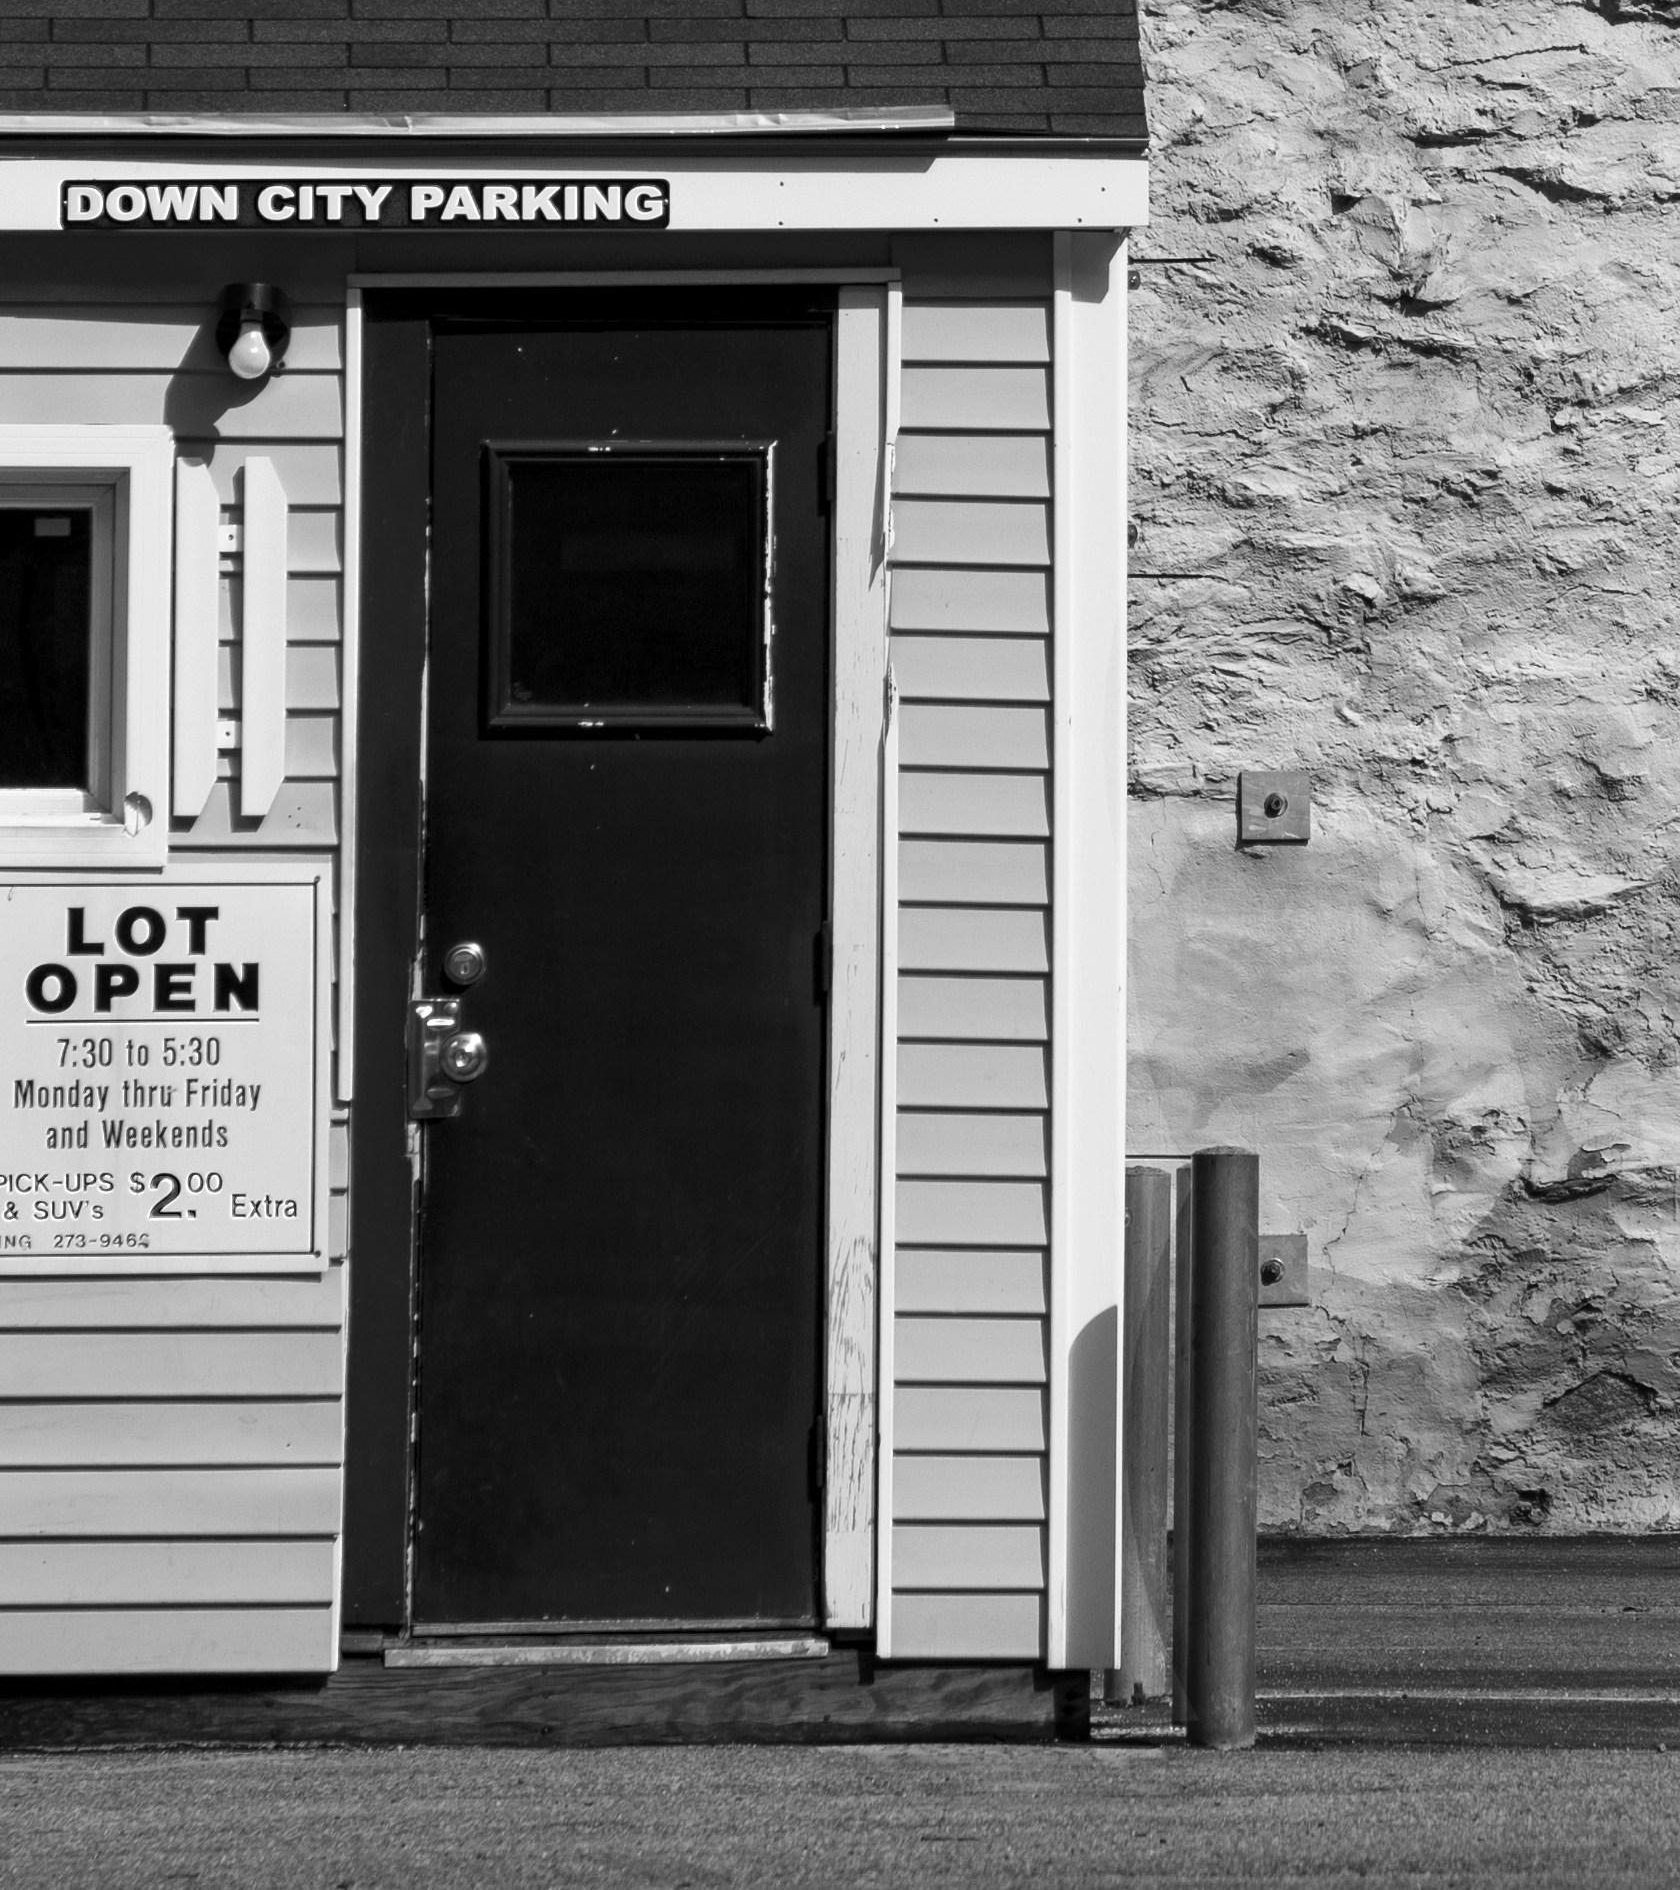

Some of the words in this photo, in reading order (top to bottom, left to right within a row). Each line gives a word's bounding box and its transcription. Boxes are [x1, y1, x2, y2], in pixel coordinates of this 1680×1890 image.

[68, 186, 238, 221] DOWN
[257, 186, 392, 221] CITY
[412, 186, 664, 221] PARKING
[68, 907, 218, 956] LOT
[25, 962, 260, 1013] OPEN
[57, 1038, 113, 1068] 7:30
[126, 1039, 149, 1066] to
[163, 1037, 220, 1066] 5:30
[13, 1079, 109, 1112] Monday
[122, 1079, 172, 1107] thru
[186, 1078, 261, 1111] Friday
[46, 1120, 88, 1149] and
[102, 1119, 228, 1149] Weekends
[3, 1201, 19, 1220] &
[33, 1200, 104, 1220] SUV's
[232, 1193, 298, 1218] Extra
